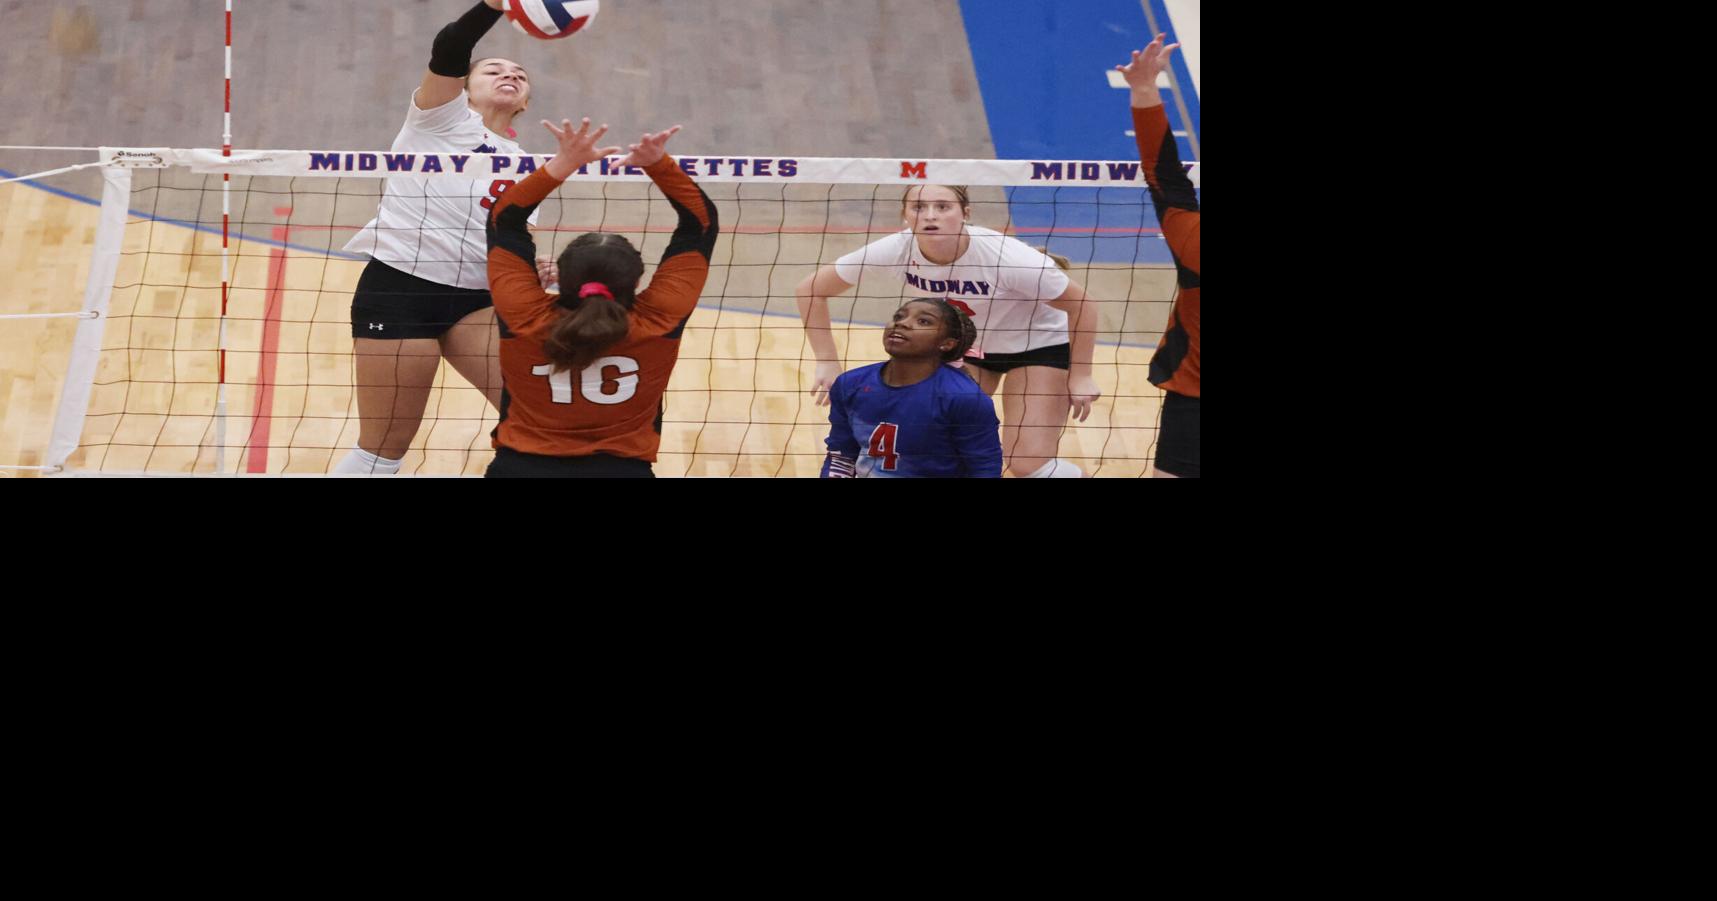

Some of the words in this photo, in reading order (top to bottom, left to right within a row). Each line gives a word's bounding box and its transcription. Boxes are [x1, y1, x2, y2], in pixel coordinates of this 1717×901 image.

[308, 152, 470, 173] MIDWAY
[490, 155, 798, 178] PATHEETTES
[900, 161, 928, 179] M
[1030, 161, 1195, 181] MIDW
[905, 272, 990, 295] MIDWAY
[531, 355, 640, 405] 16
[867, 421, 900, 472] 4
